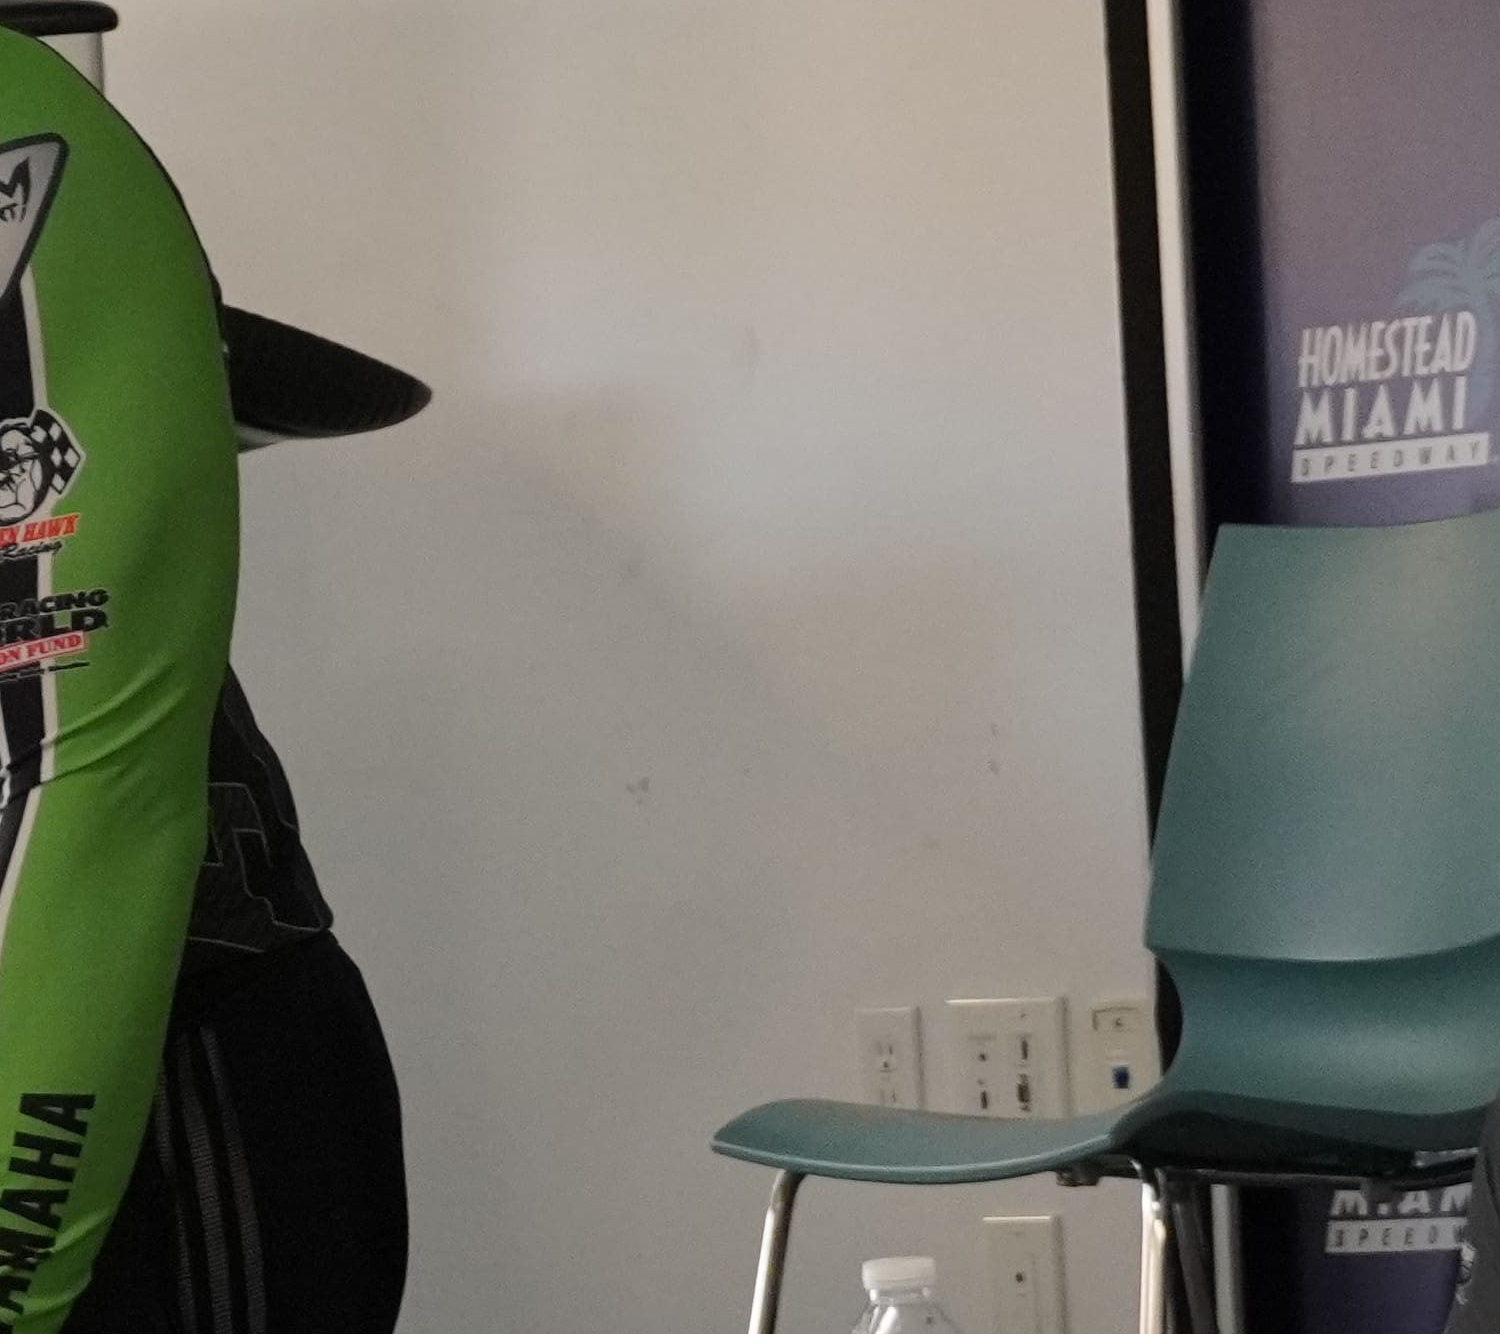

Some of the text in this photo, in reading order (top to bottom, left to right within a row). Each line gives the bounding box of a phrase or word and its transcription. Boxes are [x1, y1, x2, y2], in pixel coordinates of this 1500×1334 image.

[1297, 311, 1477, 387] HOMESTEAD
[1294, 376, 1467, 445] MIAMI
[1302, 440, 1481, 476] SPEEDWAY
[23, 514, 80, 542] HAWK
[27, 634, 82, 658] FUND
